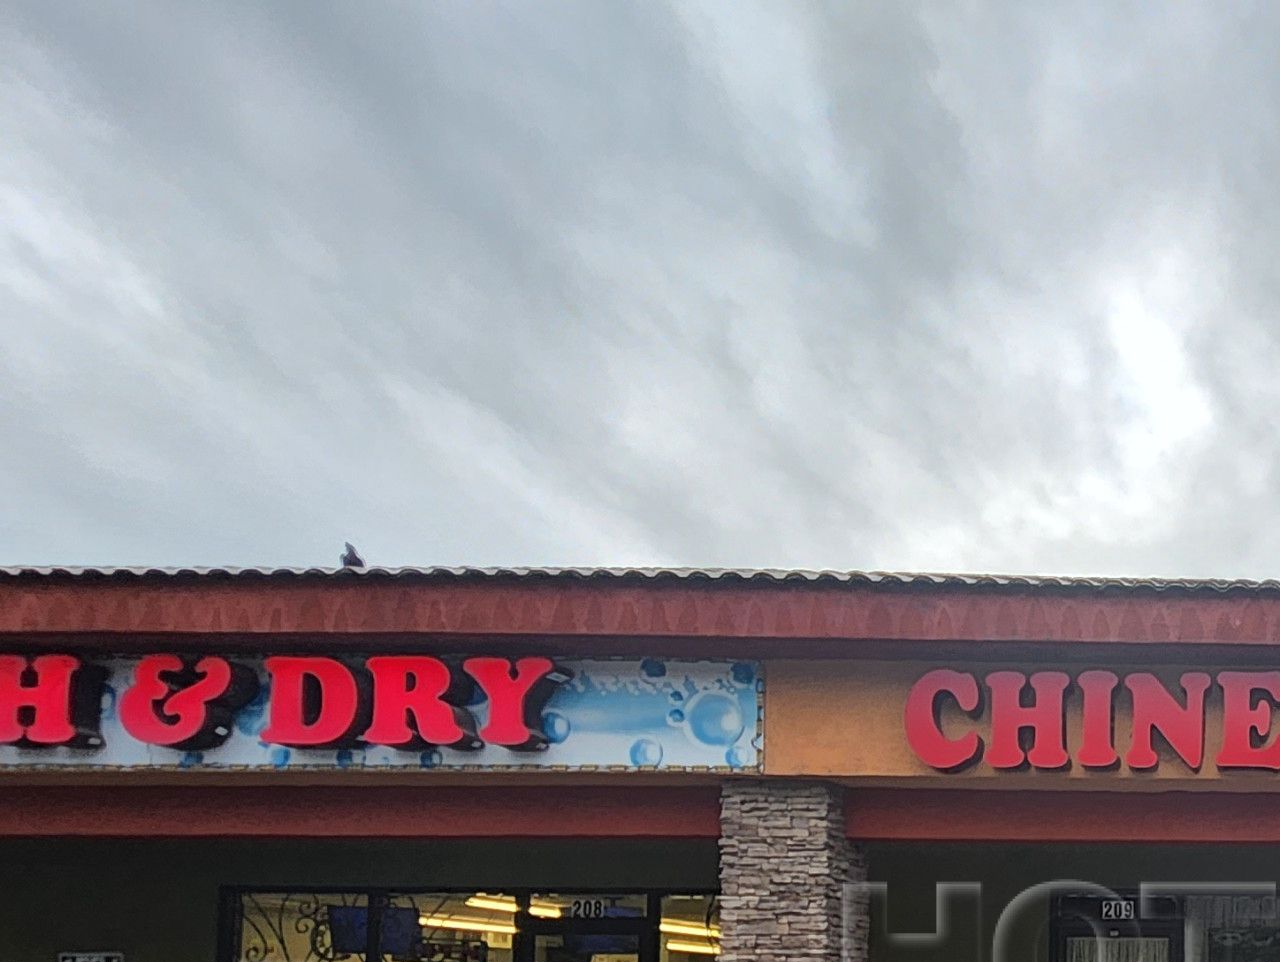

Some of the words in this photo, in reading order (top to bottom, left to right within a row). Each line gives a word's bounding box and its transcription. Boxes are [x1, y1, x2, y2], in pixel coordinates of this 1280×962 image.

[0, 655, 79, 742] H
[118, 655, 232, 745] &
[260, 656, 556, 745] DRY
[573, 901, 603, 918] 208
[1104, 902, 1133, 918] 209
